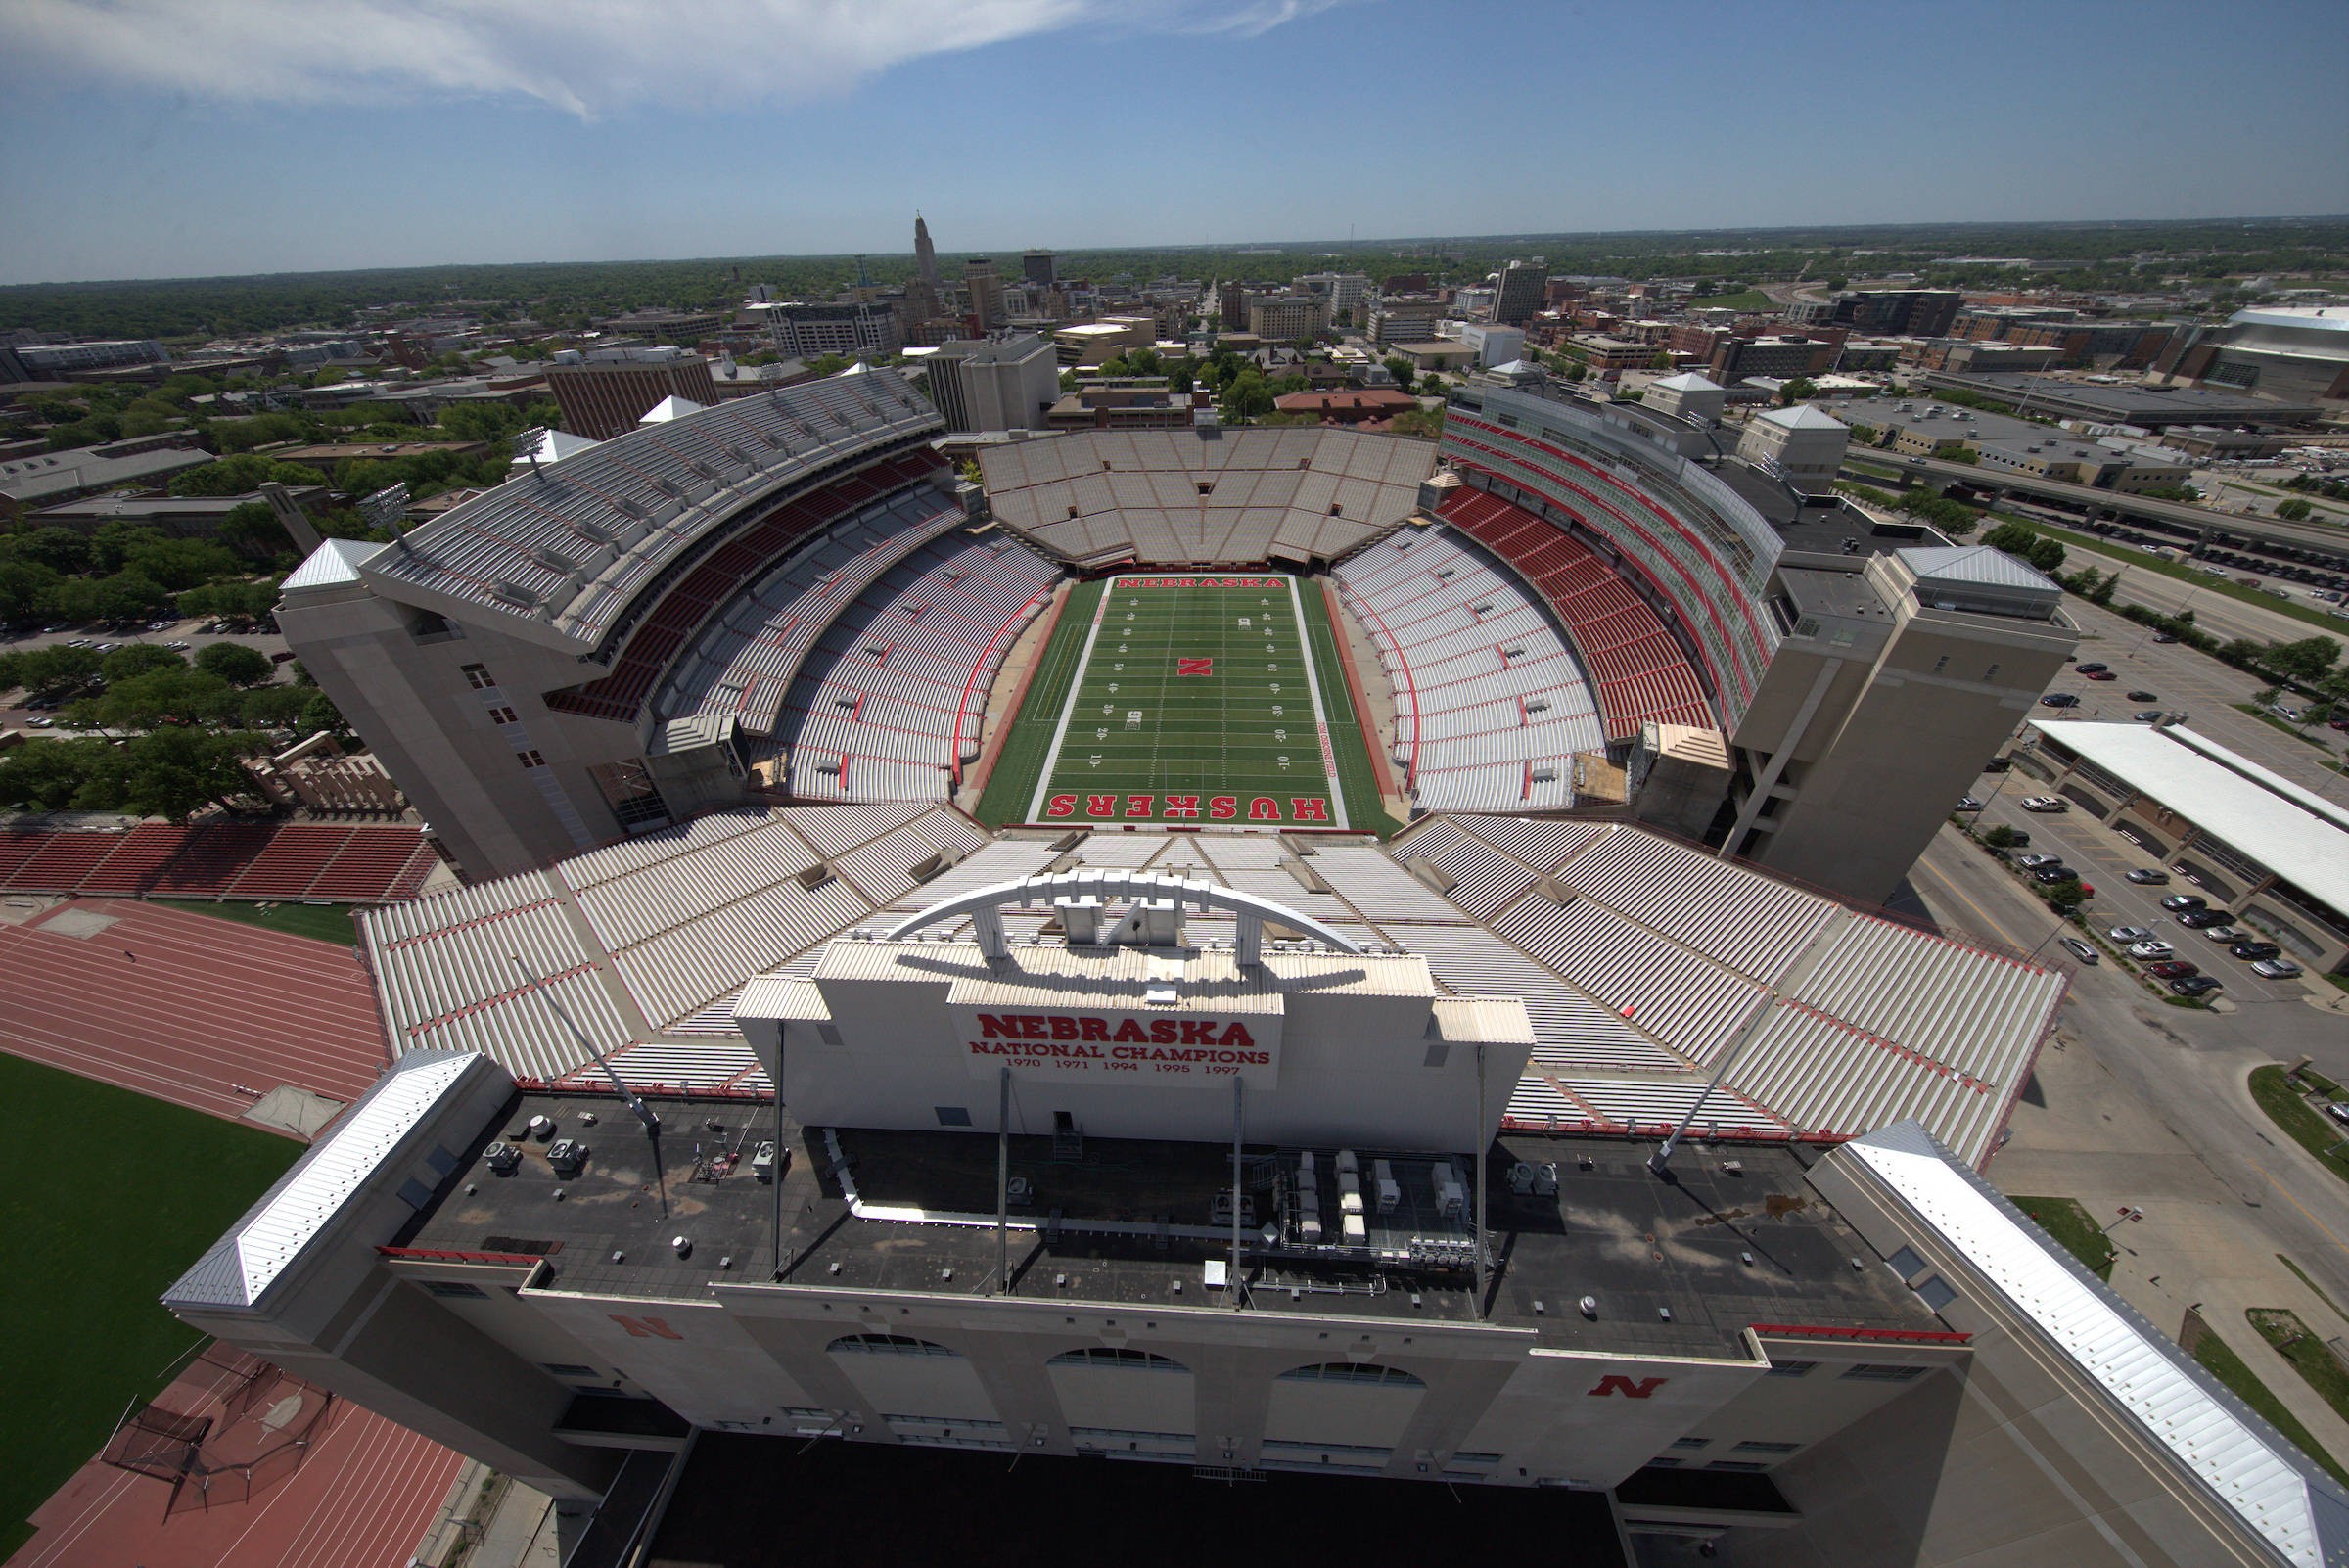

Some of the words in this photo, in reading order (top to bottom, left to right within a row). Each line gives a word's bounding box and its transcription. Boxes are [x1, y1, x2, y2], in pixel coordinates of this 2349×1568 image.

[1117, 578, 1285, 588] NEBRASKA
[1177, 657, 1213, 677] N
[1108, 682, 1119, 692] 40
[1103, 704, 1114, 714] 30
[1272, 705, 1283, 715] 30
[1096, 727, 1108, 738] 20
[1274, 728, 1287, 741] 20
[1089, 754, 1102, 765] 10
[1277, 756, 1290, 767] 10
[1047, 794, 1328, 820] HUSKERS
[977, 1014, 1255, 1047] NEBRASKA
[969, 1041, 1105, 1059] NATIONAL
[1111, 1046, 1270, 1065] CHAMPIONS
[1006, 1058, 1041, 1068] 1970
[1055, 1060, 1089, 1070] 1971
[1104, 1062, 1138, 1072] 1994
[1155, 1063, 1190, 1073] 1995
[1205, 1065, 1240, 1075] 1997
[607, 1314, 684, 1340] N
[1587, 1375, 1669, 1399] N
